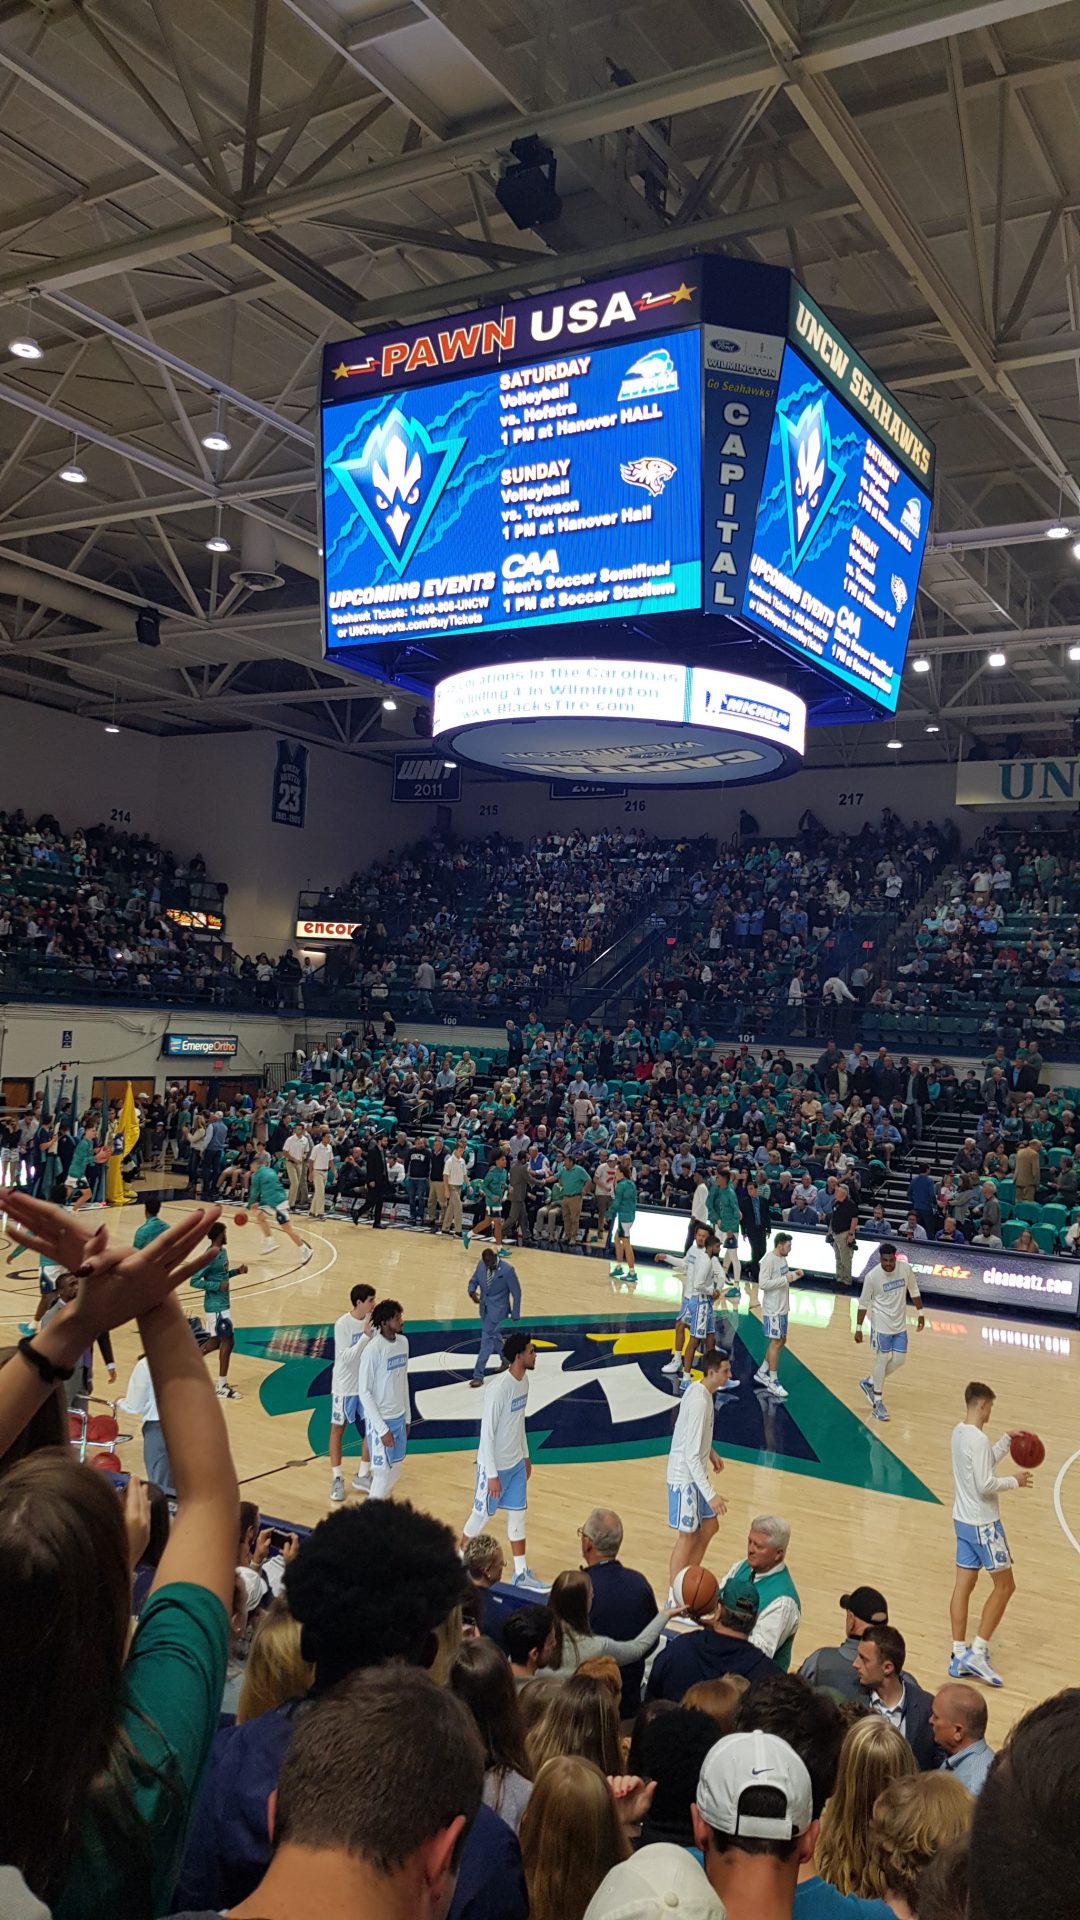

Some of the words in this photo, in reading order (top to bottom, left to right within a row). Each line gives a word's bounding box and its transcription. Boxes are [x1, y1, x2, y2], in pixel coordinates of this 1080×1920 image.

[381, 315, 516, 377] PAWN
[530, 291, 637, 342] USA
[500, 356, 591, 391] SATURDAY
[707, 358, 777, 378] WILMINGTON
[499, 382, 569, 410] Volleyball
[707, 378, 720, 389] Go
[722, 381, 775, 398] Seahawks!
[795, 300, 850, 380] UNCW
[849, 367, 932, 475] SEAHAWKS
[500, 414, 520, 428] vs.
[523, 402, 578, 424] Hofstra
[501, 430, 509, 446] 1
[512, 425, 535, 444] PM
[538, 423, 553, 440] at
[556, 412, 618, 437] Hanover
[620, 403, 663, 424] HALL
[501, 458, 571, 486] SUNDAY
[865, 438, 900, 484] SATURDAY
[500, 480, 570, 504] Volleyball
[711, 402, 750, 606] CAPITAL
[501, 509, 522, 523] vs.
[524, 500, 580, 519] Towson
[502, 525, 510, 541] 1
[514, 522, 536, 539] PM
[539, 519, 554, 536] at
[557, 512, 618, 533] Hanover
[621, 504, 652, 524] Hall
[851, 525, 880, 559] SUNDAY
[501, 549, 560, 579] CAA
[502, 577, 542, 595] Men's
[545, 572, 597, 591] Soccer
[600, 560, 670, 583] Semifinal
[328, 581, 421, 609] UPCOMING
[422, 571, 496, 598] EVENTS
[503, 599, 511, 613] 1
[515, 596, 537, 612] PM
[540, 594, 555, 609] at
[558, 589, 610, 607] Soccer
[613, 582, 676, 601] Stadium
[751, 553, 802, 604] UPCOMING
[800, 590, 836, 628] EVENTS
[331, 610, 371, 625] Seahawk
[372, 607, 408, 621] Tickets:
[836, 605, 861, 639] CAA
[337, 628, 347, 638] or
[551, 667, 579, 679] the
[549, 683, 659, 699] Wilmington
[414, 783, 442, 797] 2011
[998, 761, 1080, 800] UN
[279, 782, 301, 813] 23
[479, 804, 498, 816] 215
[624, 800, 646, 813] 216
[838, 793, 864, 806] 217
[109, 808, 131, 824] 214
[304, 922, 355, 936] encor
[442, 1017, 457, 1026] 100
[182, 1040, 236, 1054] EmergeOrtho
[737, 1034, 756, 1044] 101
[983, 1266, 1073, 1296] cleaneatz.com
